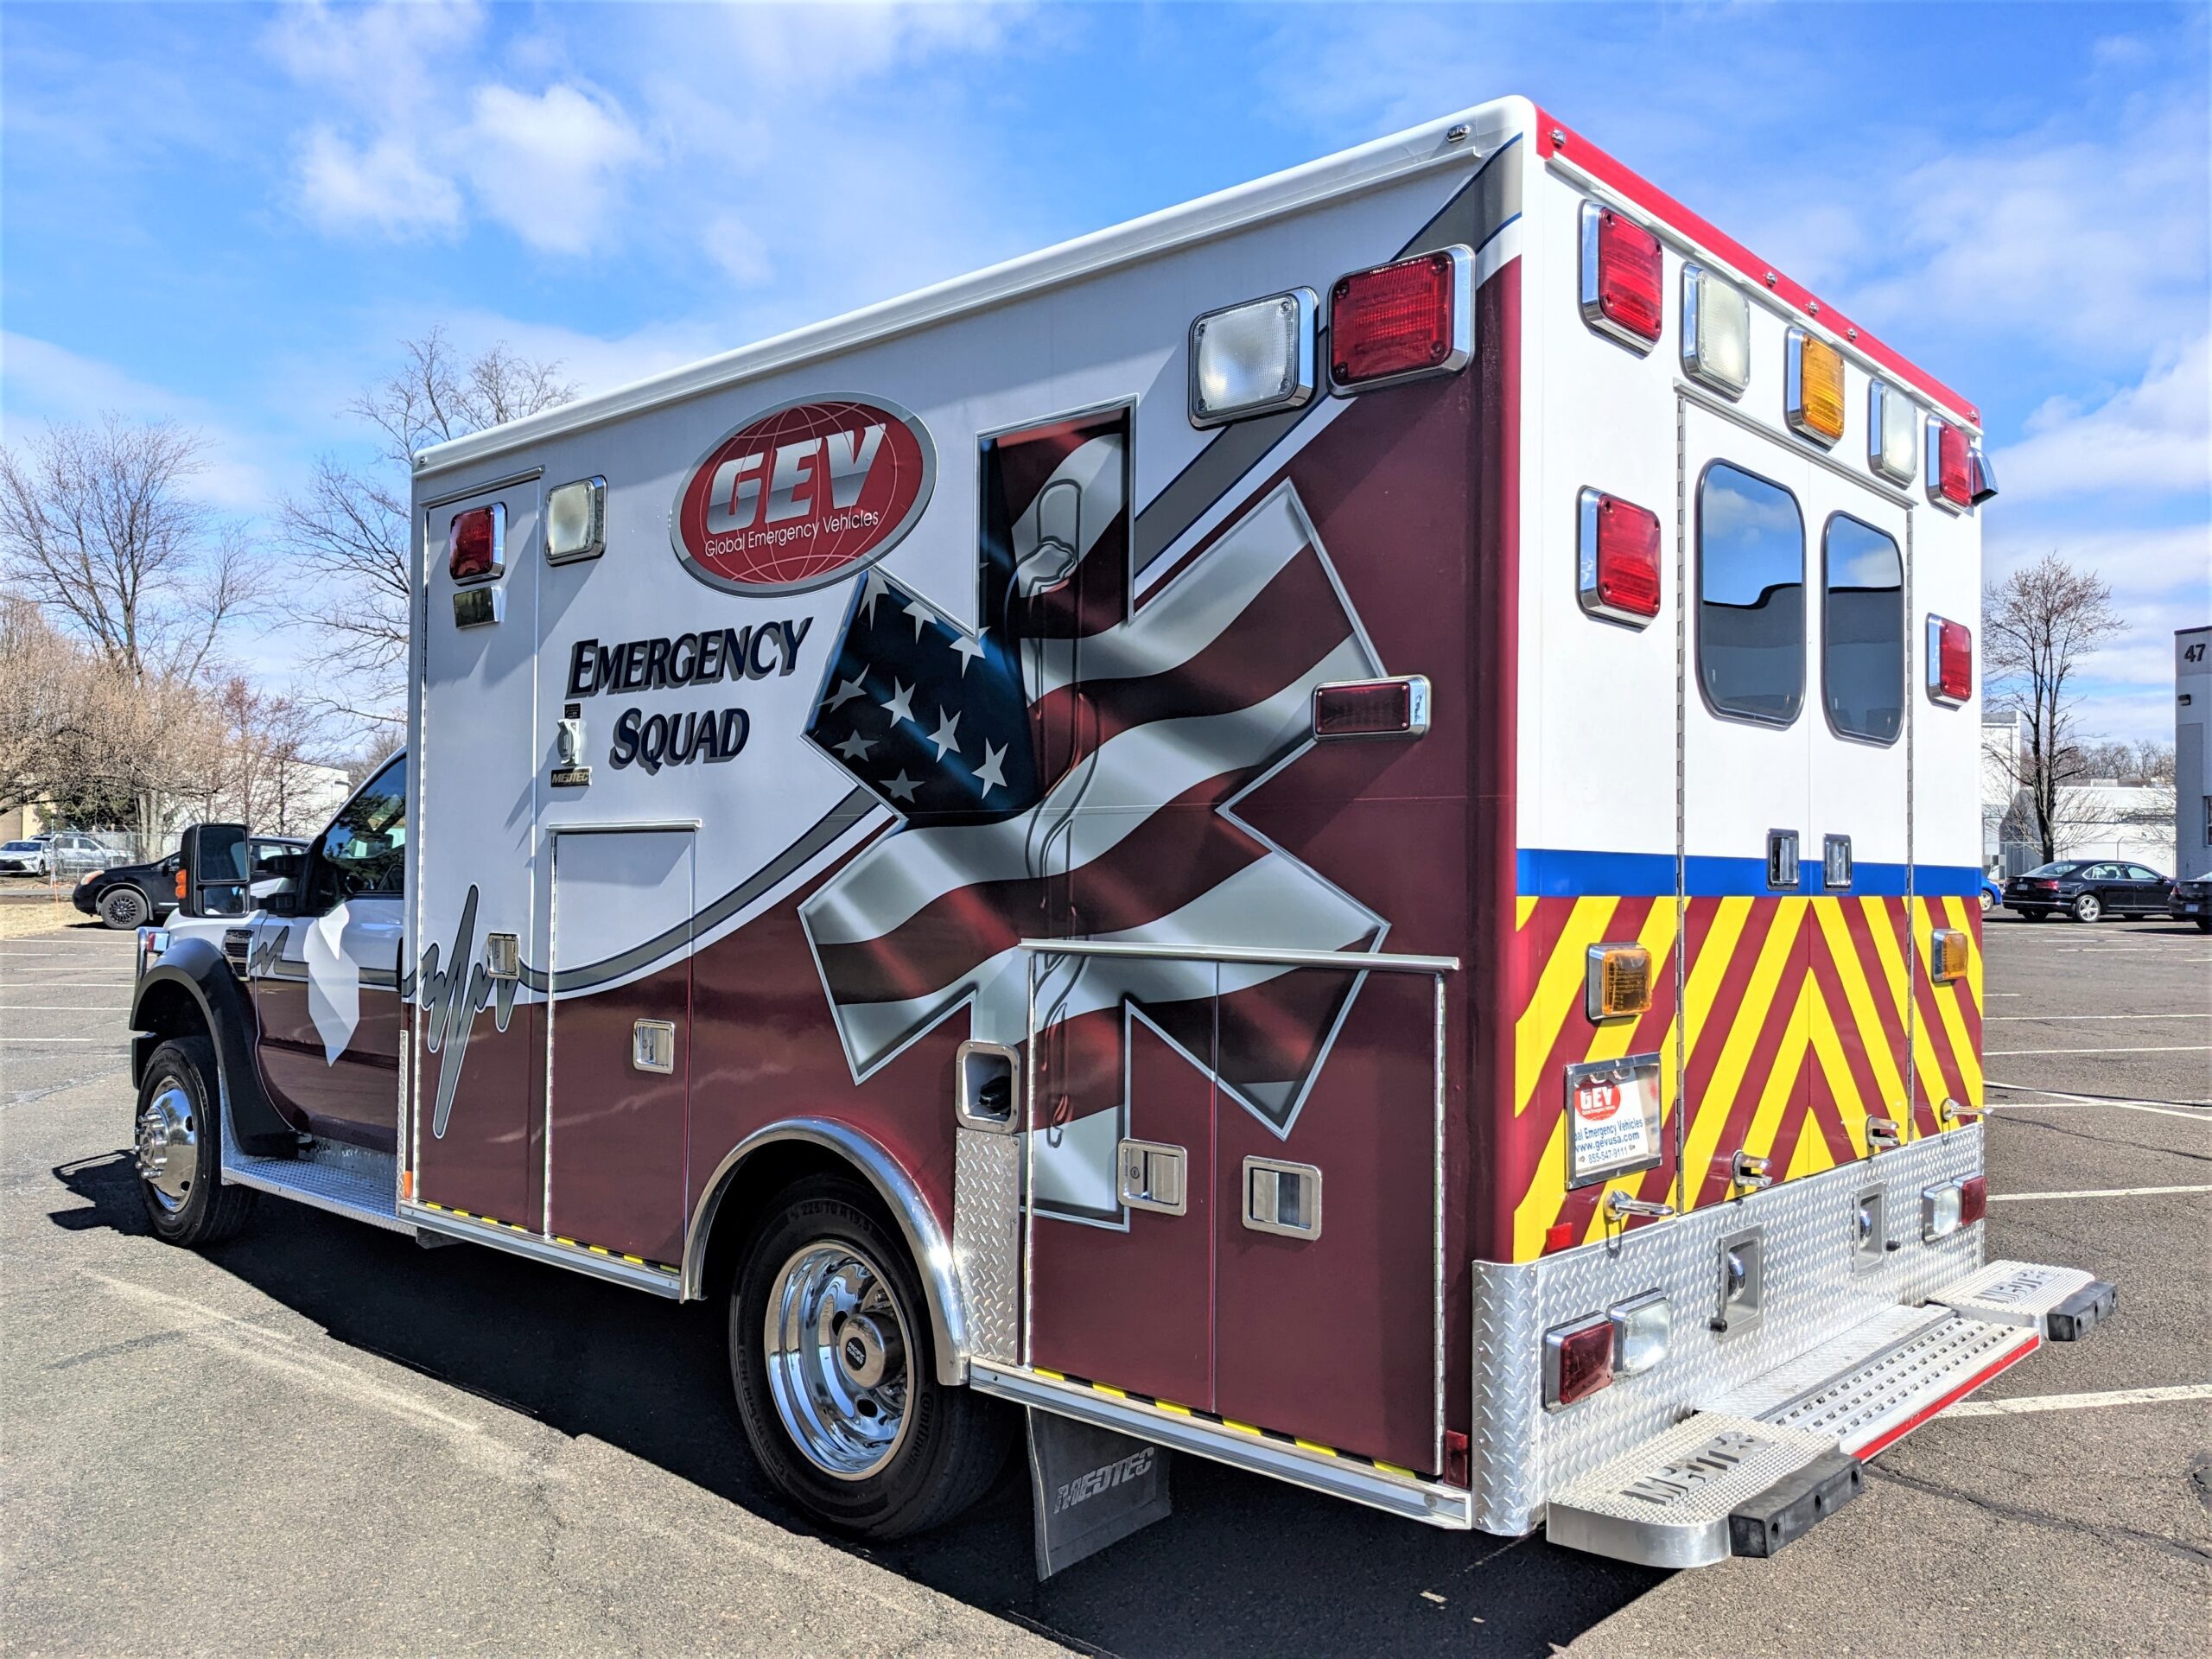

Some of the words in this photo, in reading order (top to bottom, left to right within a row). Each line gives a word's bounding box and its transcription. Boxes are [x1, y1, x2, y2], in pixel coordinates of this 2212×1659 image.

[707, 423, 886, 535] GEV
[705, 533, 746, 557] Global
[748, 522, 820, 550] Emergency
[823, 510, 880, 534] Vehicles
[565, 616, 814, 700] EMERGENCY
[2184, 644, 2206, 662] 47
[609, 707, 750, 776] SQUAD
[551, 772, 589, 784] MEDTEC
[1580, 1086, 1612, 1109] GEV
[1584, 1125, 1617, 1140] Emergency
[1618, 1117, 1644, 1132] Vehicles
